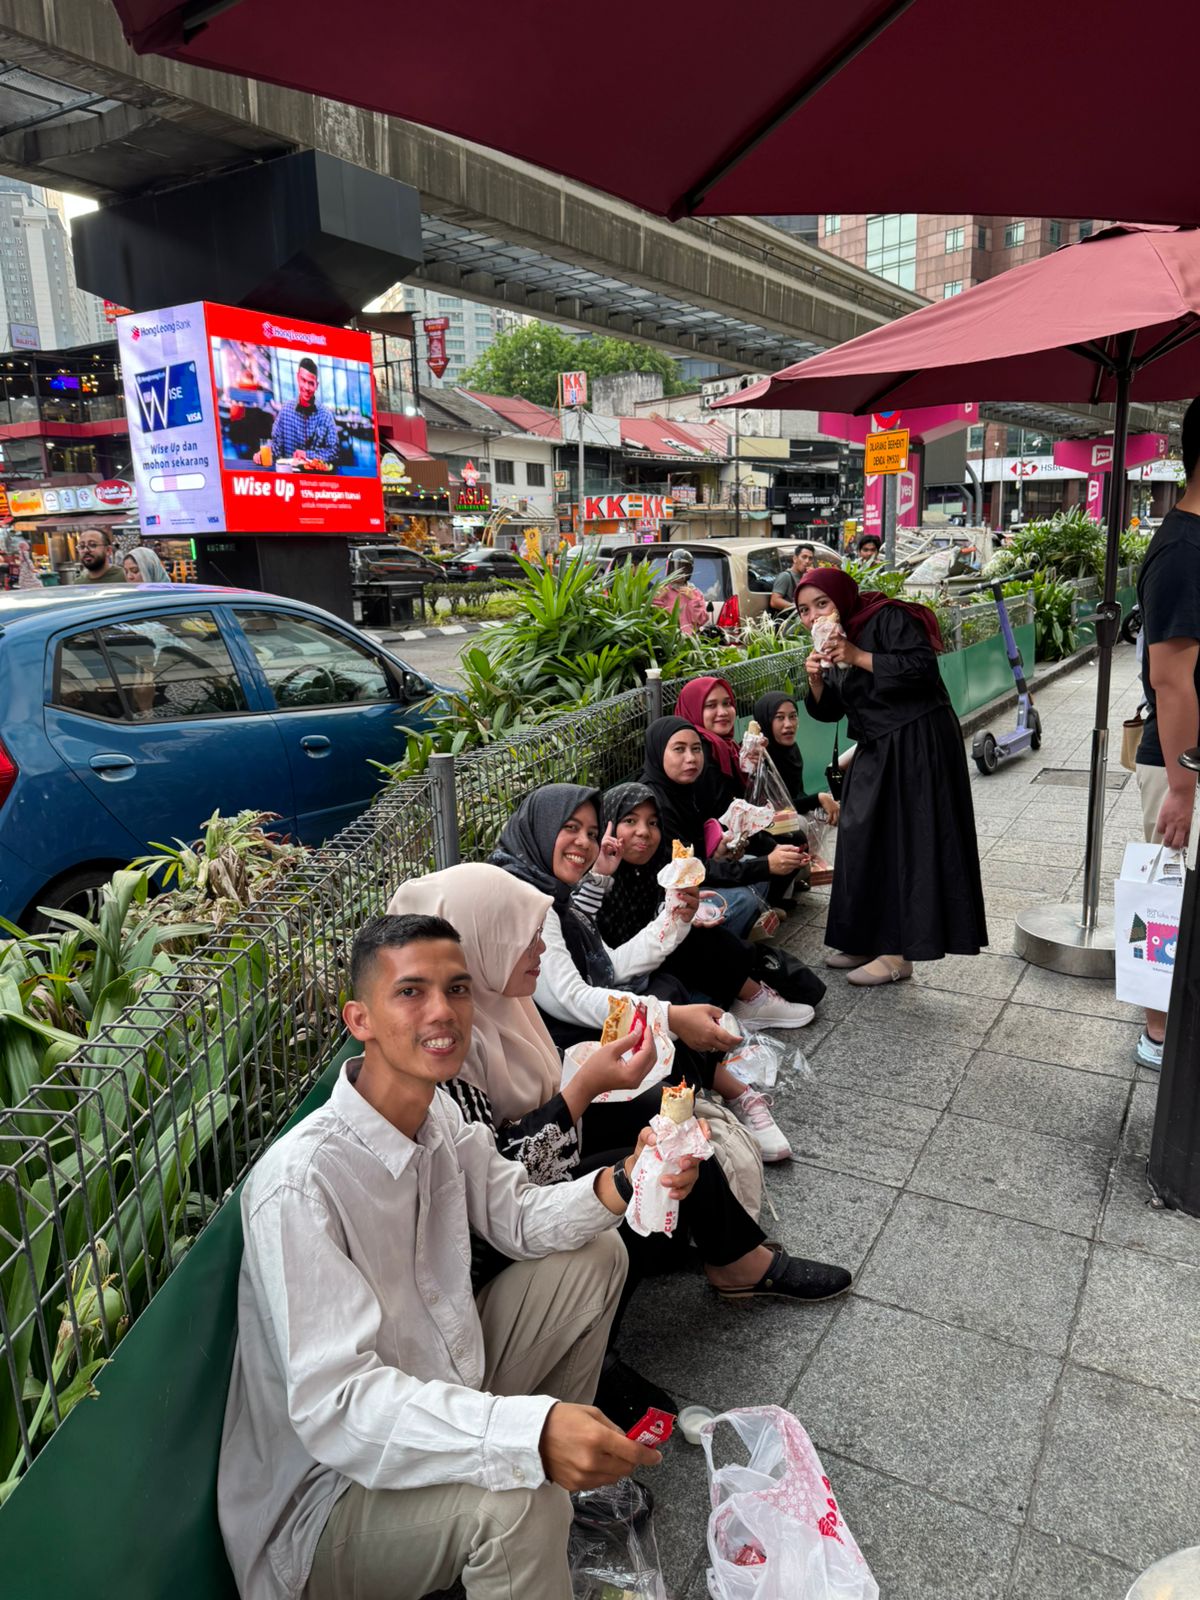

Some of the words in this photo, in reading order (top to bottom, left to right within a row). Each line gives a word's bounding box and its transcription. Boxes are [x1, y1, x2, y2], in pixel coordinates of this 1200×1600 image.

[564, 373, 583, 391] KK
[185, 411, 202, 423] VISA
[150, 444, 169, 455] Wise
[170, 442, 181, 455] Up
[182, 441, 198, 452] dan
[142, 459, 170, 471] mohon
[171, 456, 209, 468] sekarang
[1040, 464, 1064, 472] HSBC
[232, 476, 272, 496] Wise
[275, 478, 295, 502] Up
[901, 485, 912, 499] yes
[586, 495, 627, 519] KK
[643, 495, 665, 518] KK
[207, 516, 220, 524] VISA
